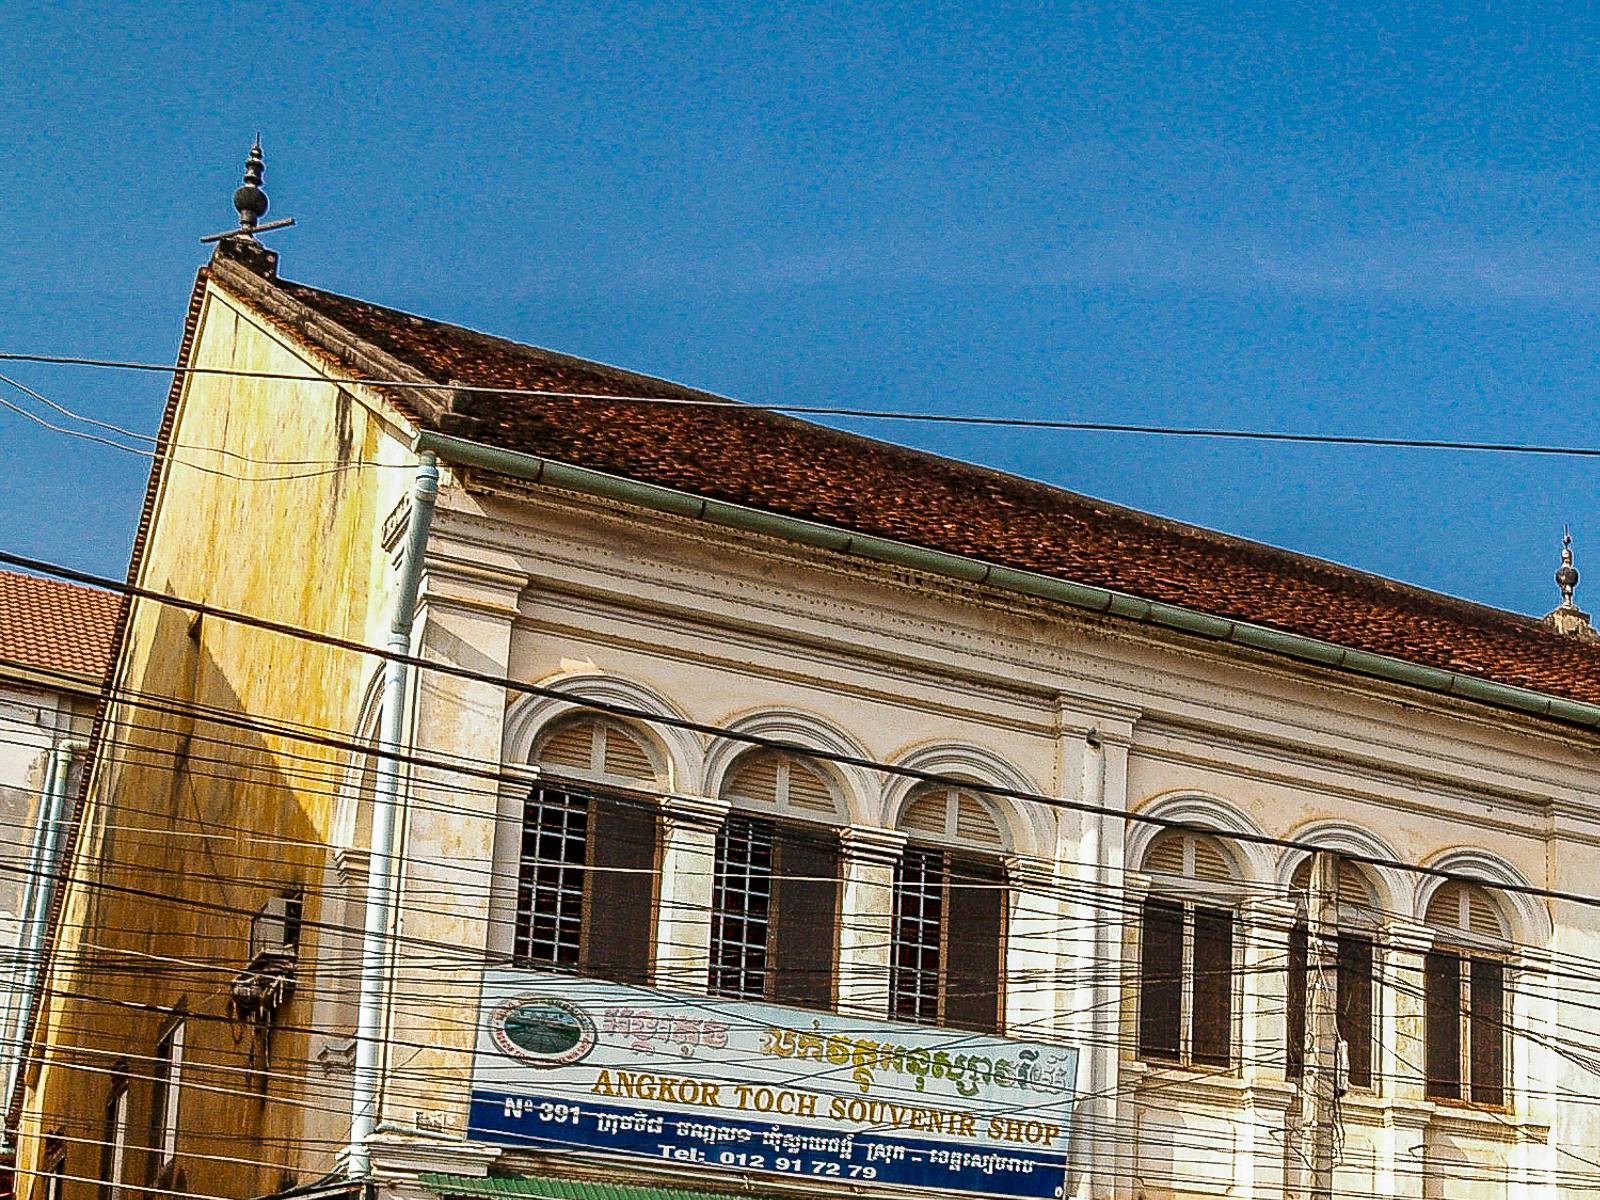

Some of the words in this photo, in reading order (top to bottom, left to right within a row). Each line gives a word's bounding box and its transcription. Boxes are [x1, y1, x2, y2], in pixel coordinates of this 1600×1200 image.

[591, 1069, 720, 1106] ANGKOR
[734, 1083, 816, 1118] TOCH
[829, 1095, 977, 1137] SOUVENIR
[987, 1116, 1061, 1146] SHOP
[658, 1144, 706, 1163] Tel:
[720, 1151, 766, 1168] 012
[775, 1157, 802, 1172] 91
[811, 1160, 841, 1177] 72
[848, 1164, 877, 1179] 79
